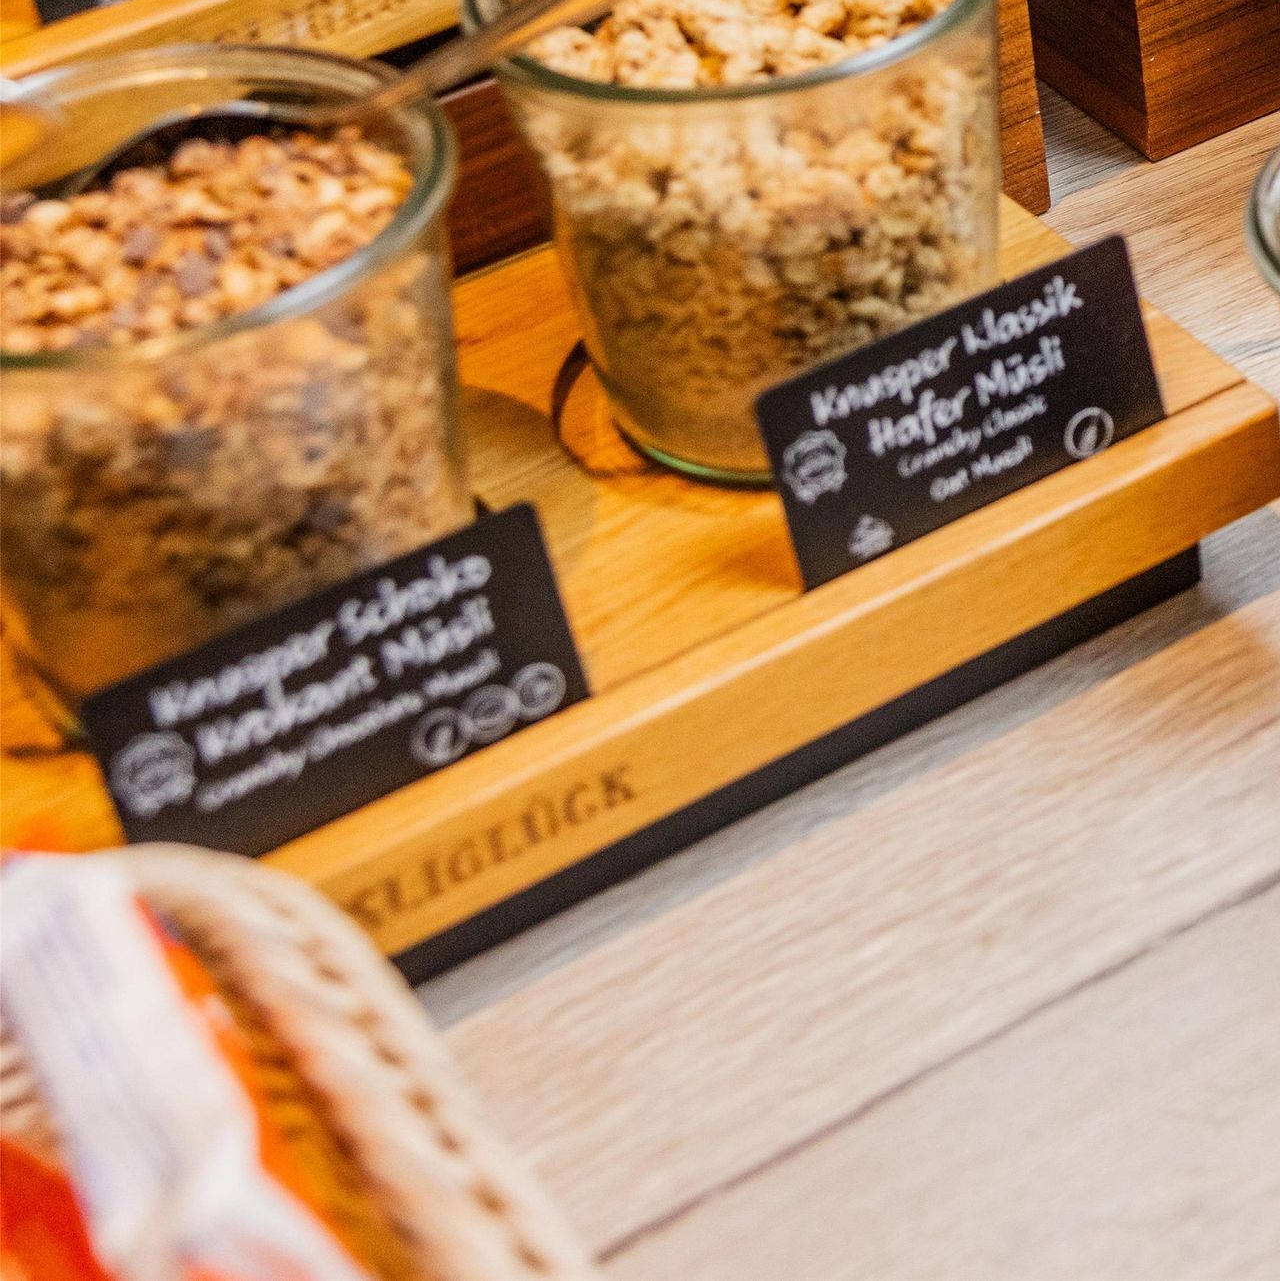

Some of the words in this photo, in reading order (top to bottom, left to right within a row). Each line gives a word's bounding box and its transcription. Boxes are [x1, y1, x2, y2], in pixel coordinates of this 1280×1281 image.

[810, 336, 957, 426] Knusper
[960, 275, 1085, 355] Klassik
[867, 384, 972, 458] Hafer
[974, 334, 1067, 406] Müsli
